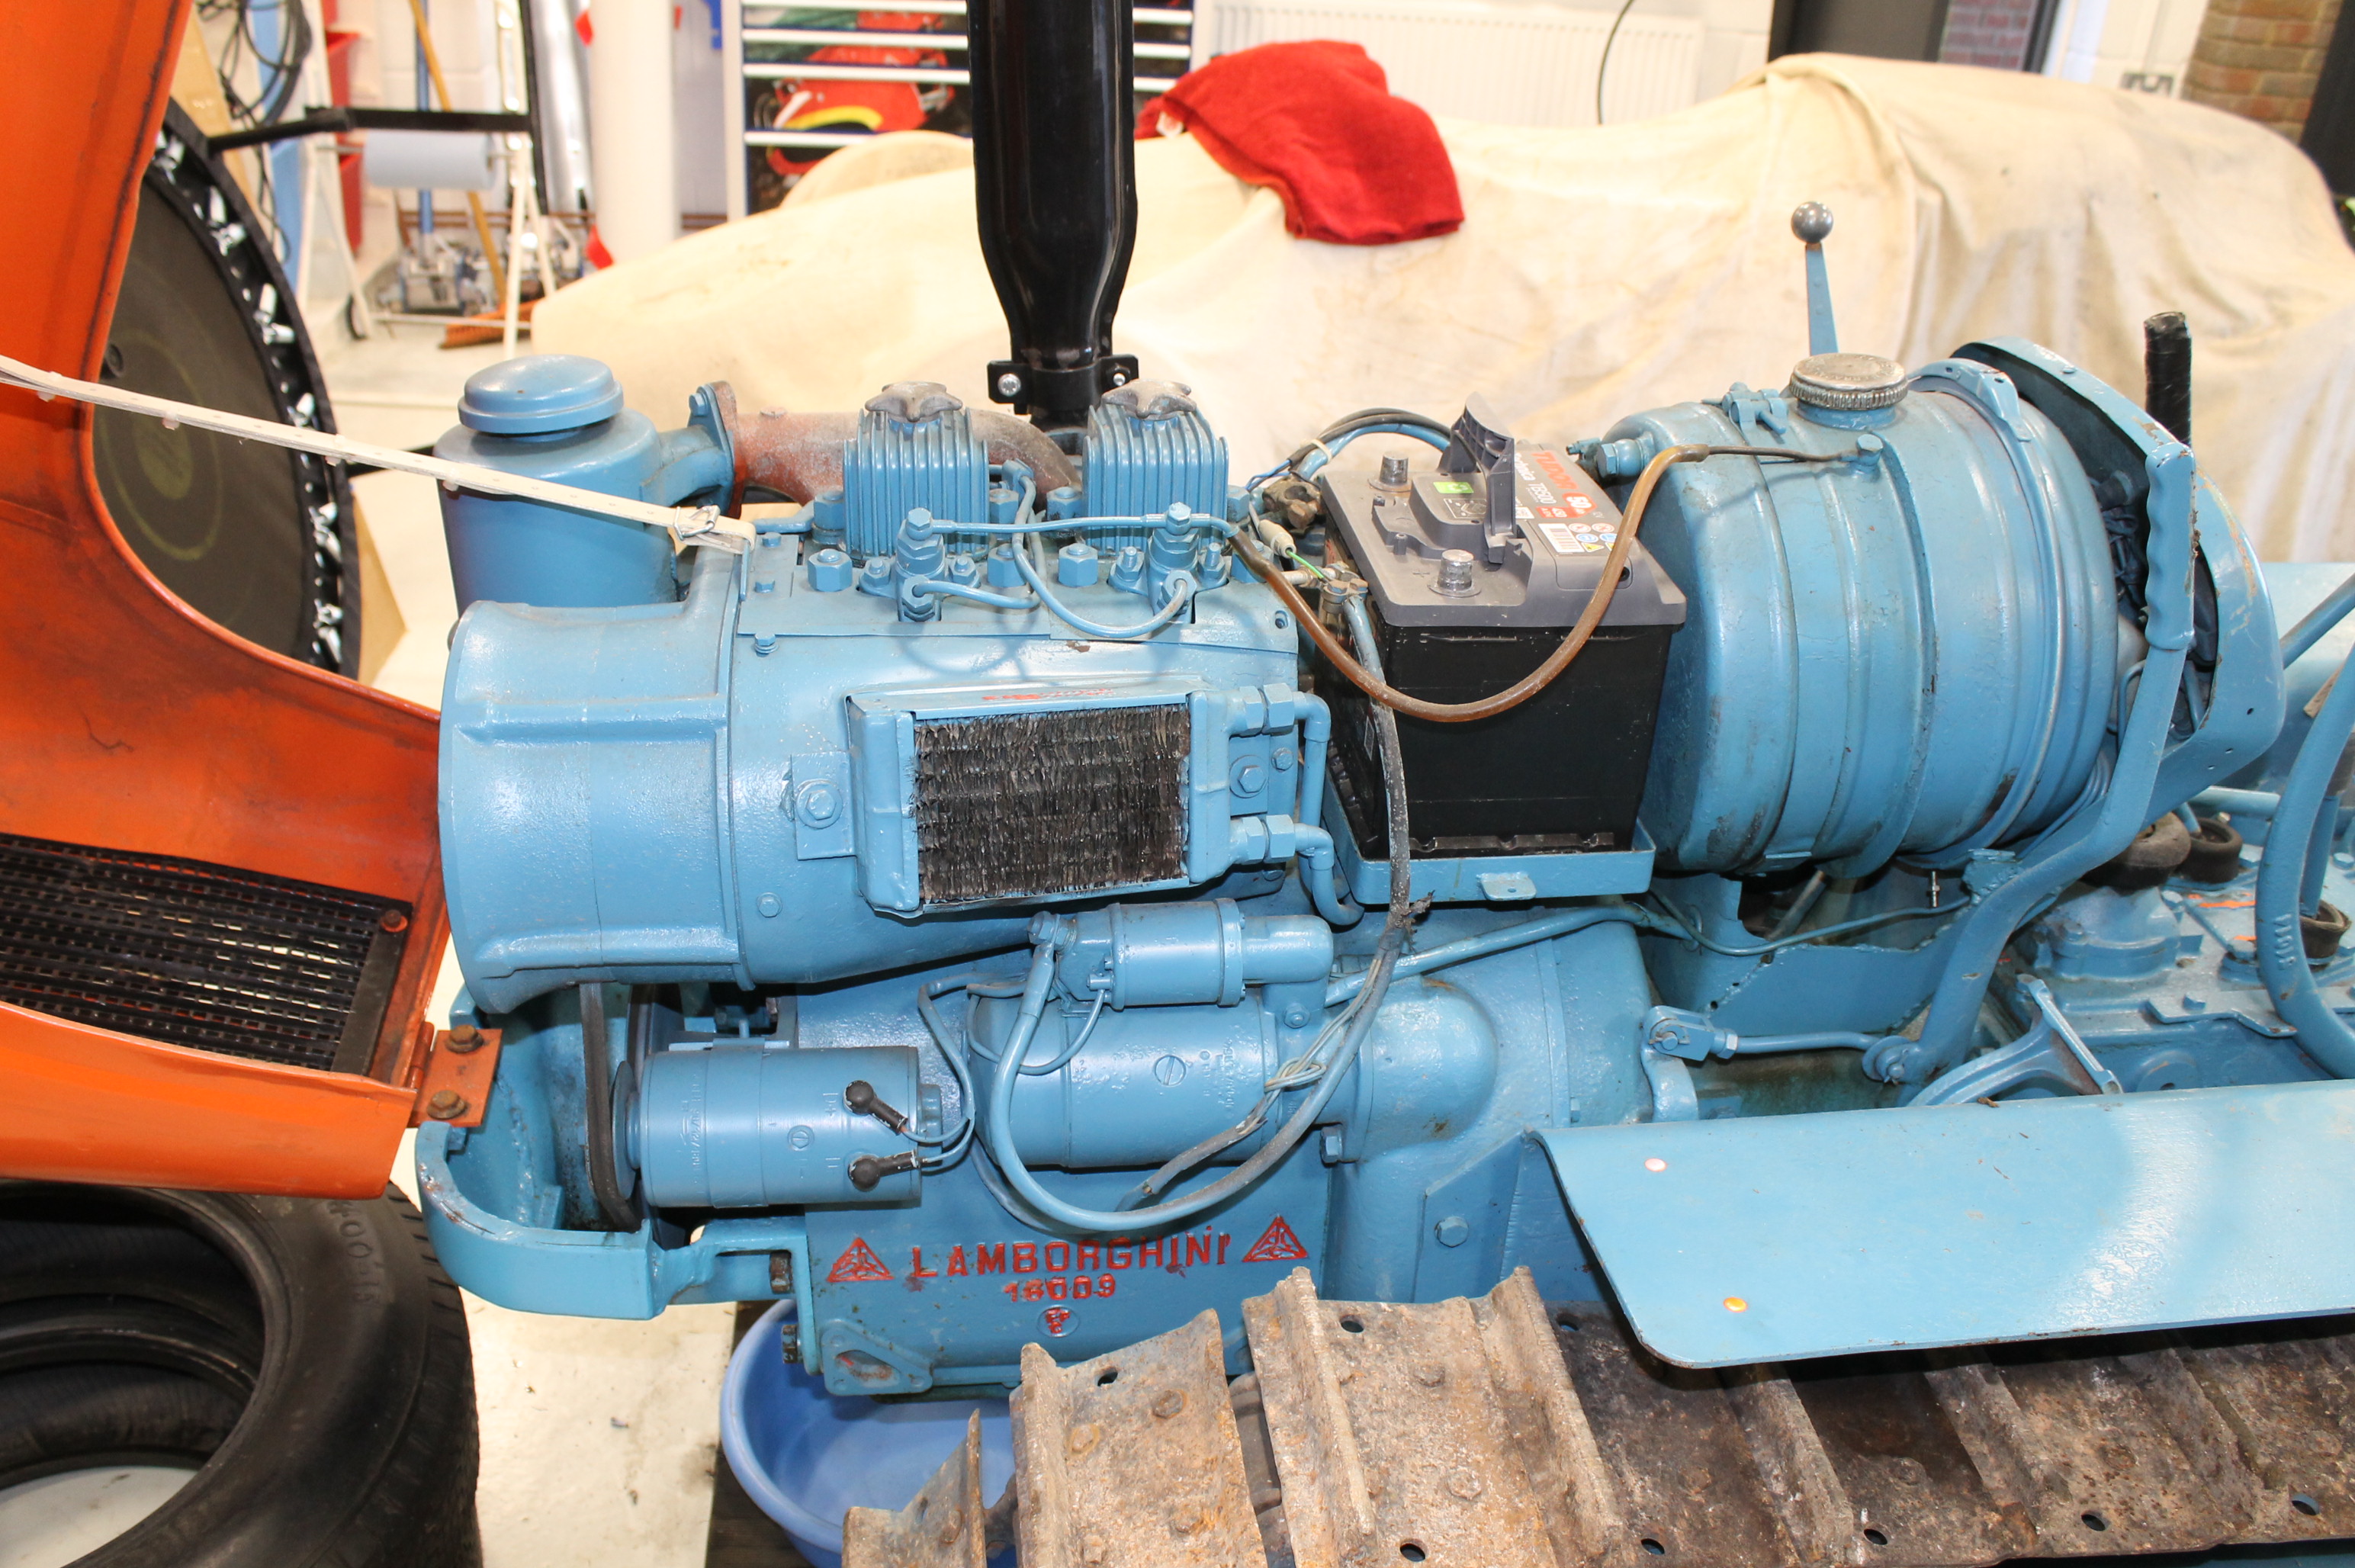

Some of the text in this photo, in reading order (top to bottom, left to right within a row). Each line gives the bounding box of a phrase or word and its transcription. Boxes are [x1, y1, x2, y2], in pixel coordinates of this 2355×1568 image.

[1531, 451, 1579, 490] TUDOR
[1528, 483, 1557, 504] TB500
[1566, 496, 1592, 509] 50
[911, 1229, 1231, 1278] LAMBORGHINI
